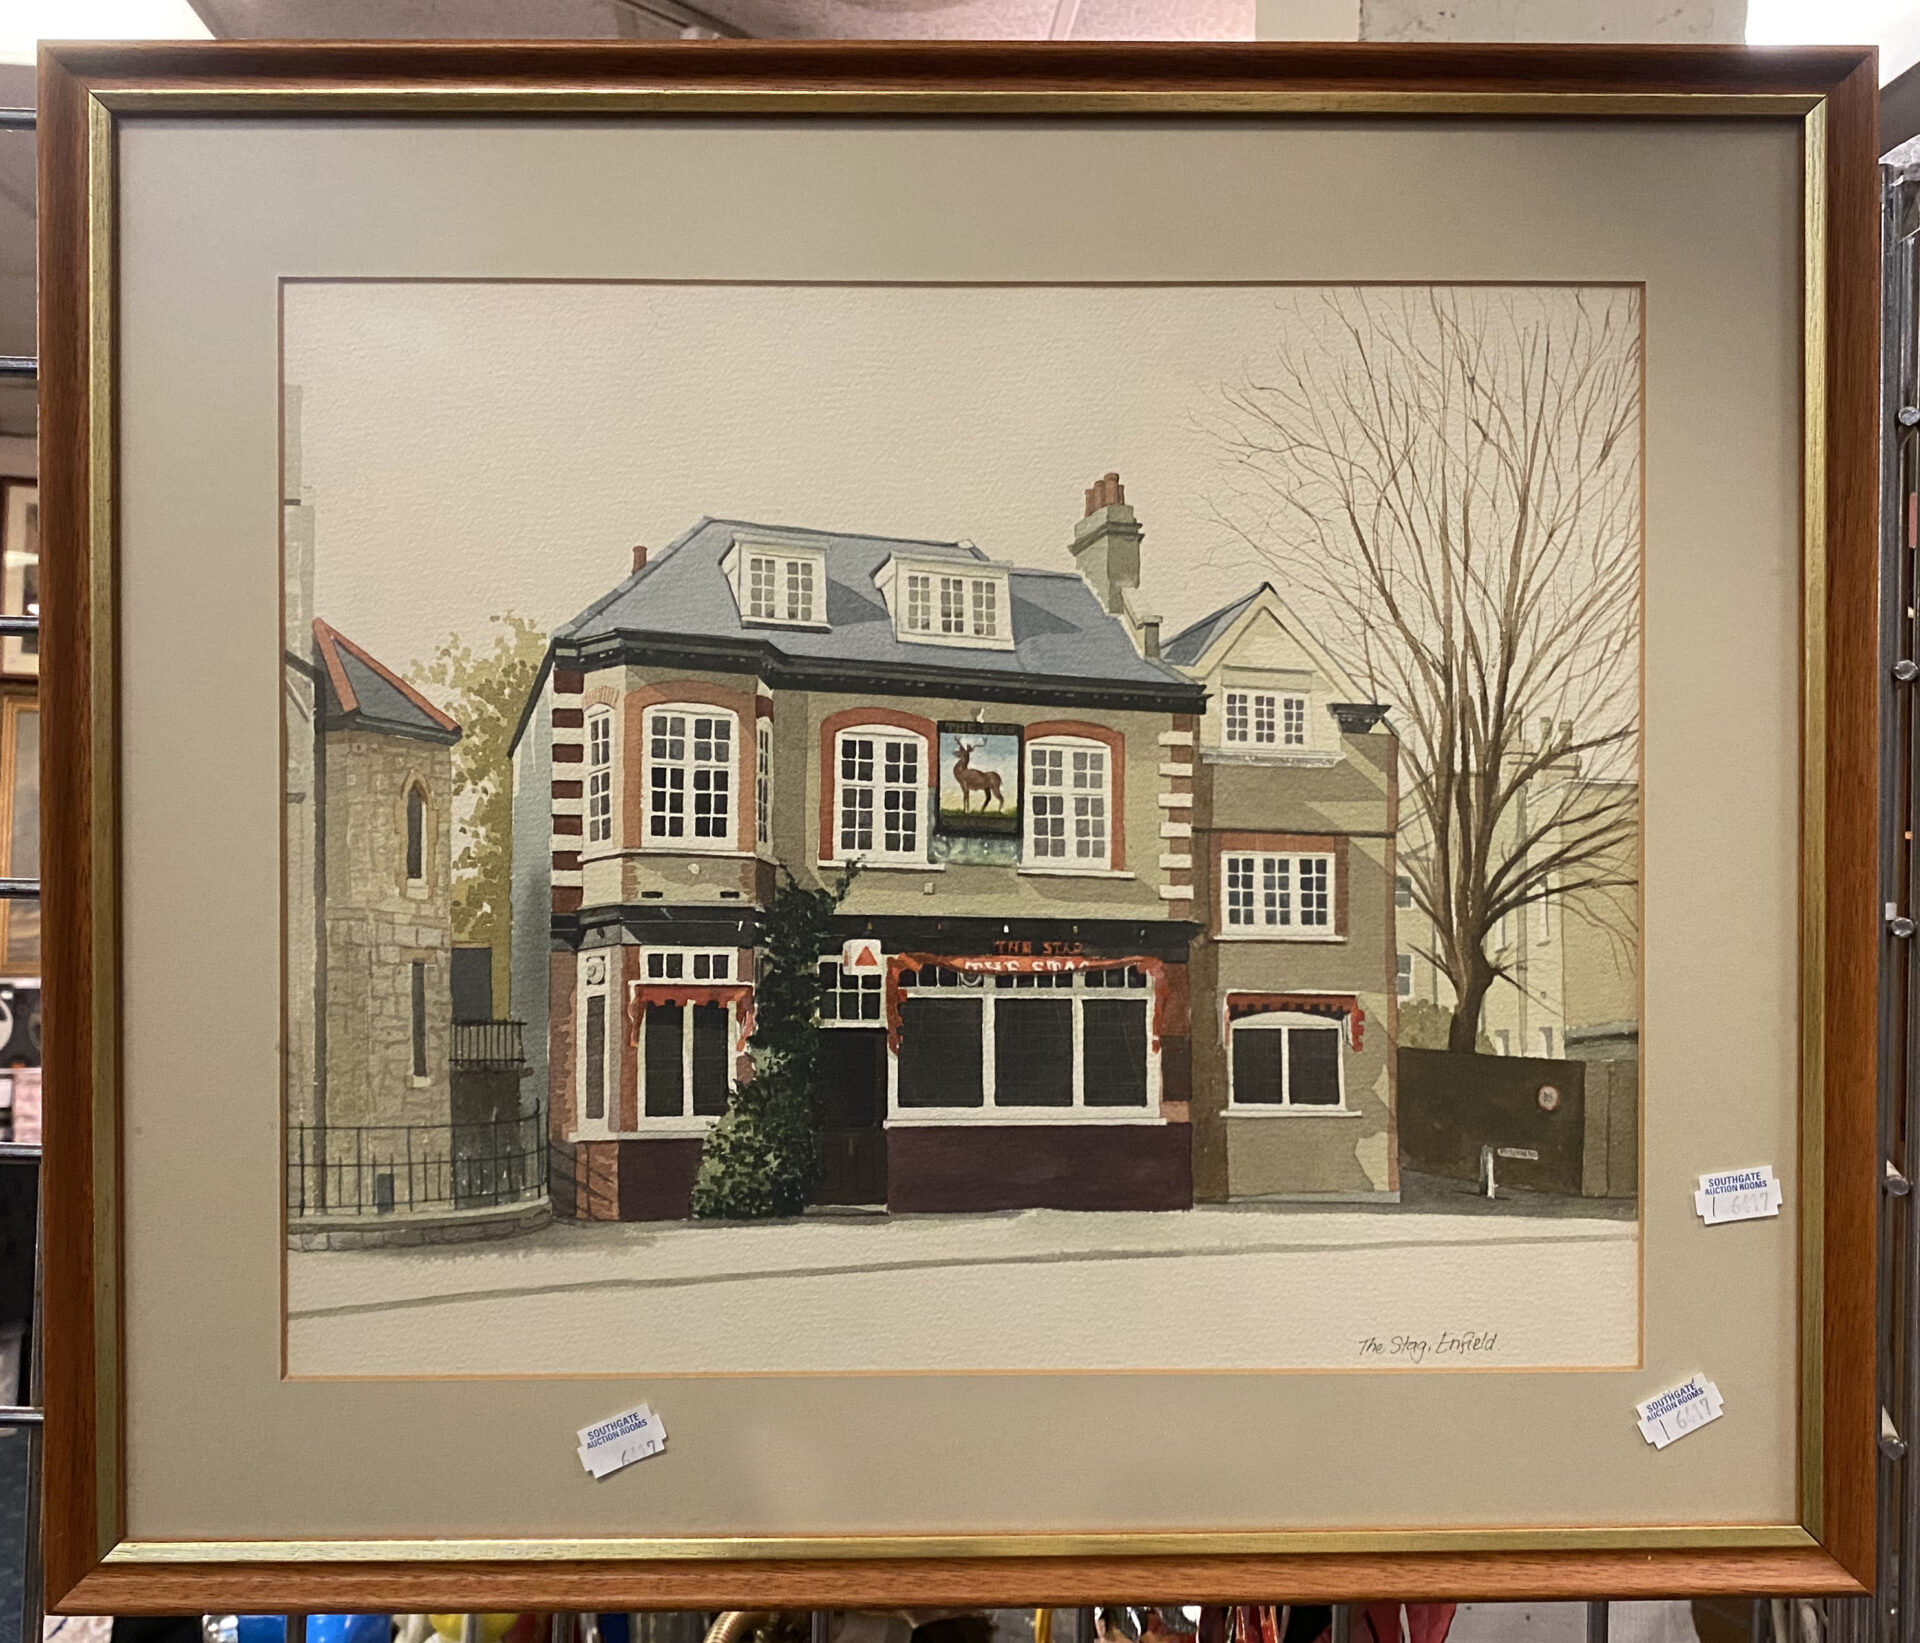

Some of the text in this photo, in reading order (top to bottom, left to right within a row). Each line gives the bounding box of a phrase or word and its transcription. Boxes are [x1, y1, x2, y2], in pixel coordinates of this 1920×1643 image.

[994, 940, 1032, 954] THE
[1704, 1180, 1768, 1196] AUCTION ROOMS
[1708, 1171, 1761, 1188] SOUTHGATE
[1358, 1337, 1385, 1356] The
[1435, 1331, 1498, 1355] Enfield
[1646, 1382, 1697, 1414] SOUTHGATE
[1646, 1387, 1704, 1423] AUCTION ROOMS
[586, 1418, 648, 1450] AUCTION ROOMS
[587, 1411, 640, 1441] SOUTHGATE
